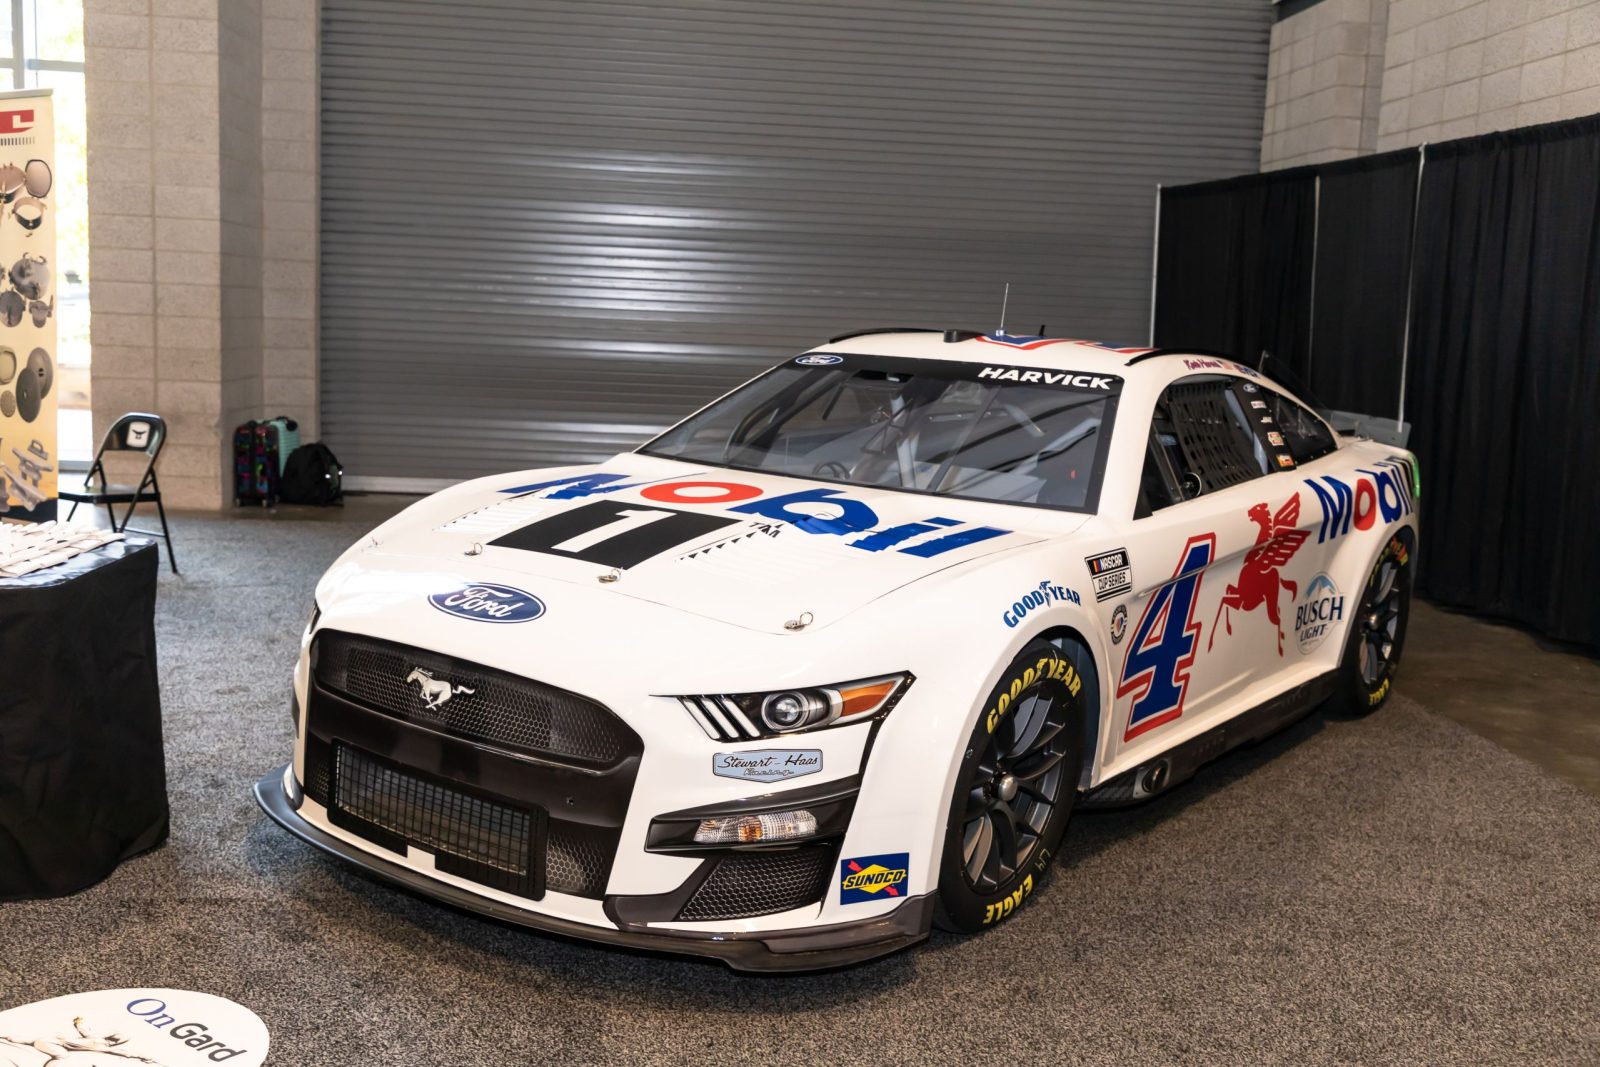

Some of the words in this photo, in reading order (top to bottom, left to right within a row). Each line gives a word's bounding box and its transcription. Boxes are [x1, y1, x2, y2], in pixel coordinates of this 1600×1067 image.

[977, 366, 1114, 390] HARVICK
[496, 472, 1014, 559] Mobil
[551, 508, 677, 553] 1
[1100, 554, 1124, 571] NASCAR
[1098, 576, 1109, 590] CUP
[1108, 572, 1126, 587] SERIES
[442, 586, 526, 618] Ford
[1295, 596, 1344, 631] BUSCH
[1116, 532, 1216, 743] 4
[1300, 624, 1328, 642] LIGHT
[845, 870, 905, 888] SUNOCO
[982, 874, 1033, 924] EAGLE
